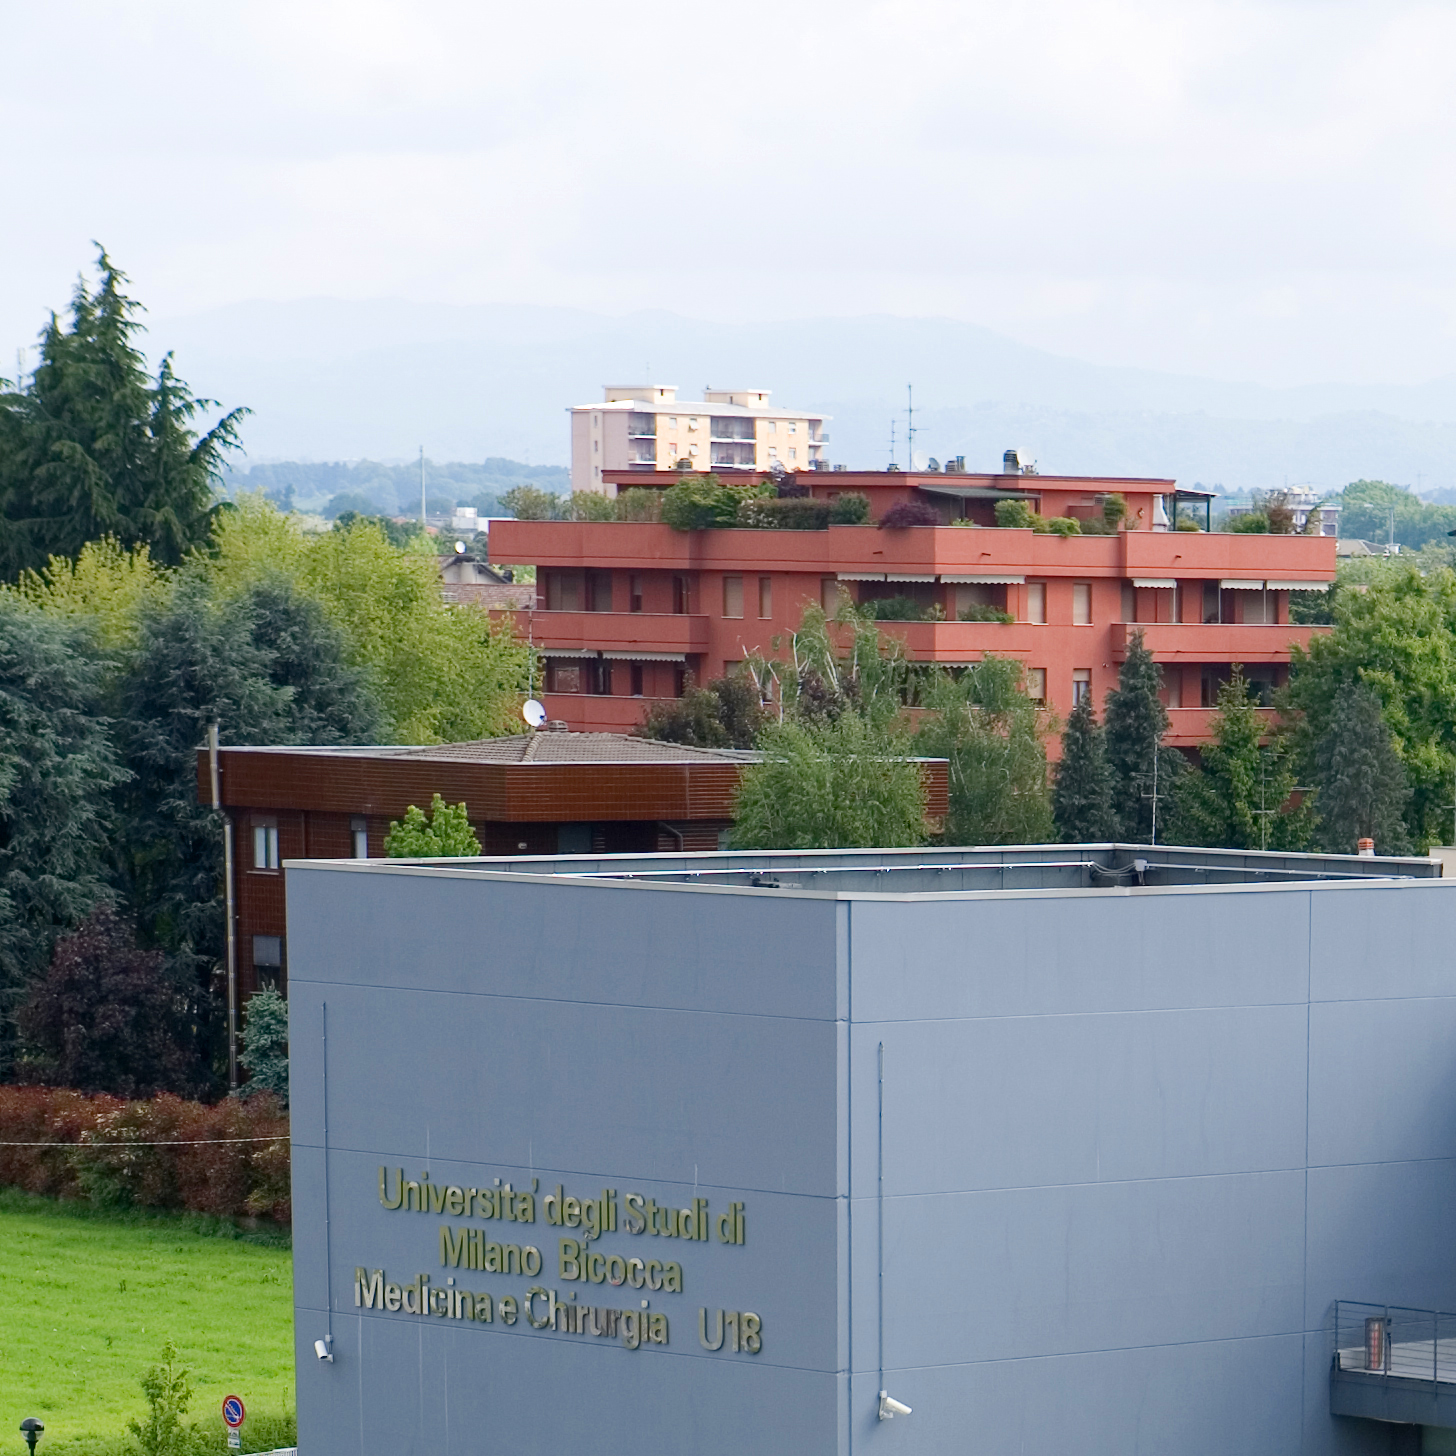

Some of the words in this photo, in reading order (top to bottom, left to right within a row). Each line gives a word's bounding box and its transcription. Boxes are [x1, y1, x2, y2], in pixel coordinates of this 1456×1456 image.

[543, 1185, 617, 1240] degli
[624, 1193, 709, 1242] Studi
[716, 1202, 746, 1245] di
[439, 1225, 543, 1277] Milano
[558, 1237, 683, 1293] Bicocca
[354, 1267, 493, 1323] Medicina
[499, 1296, 518, 1325] e
[524, 1286, 670, 1350] Chirurgia
[699, 1307, 763, 1355] U18
